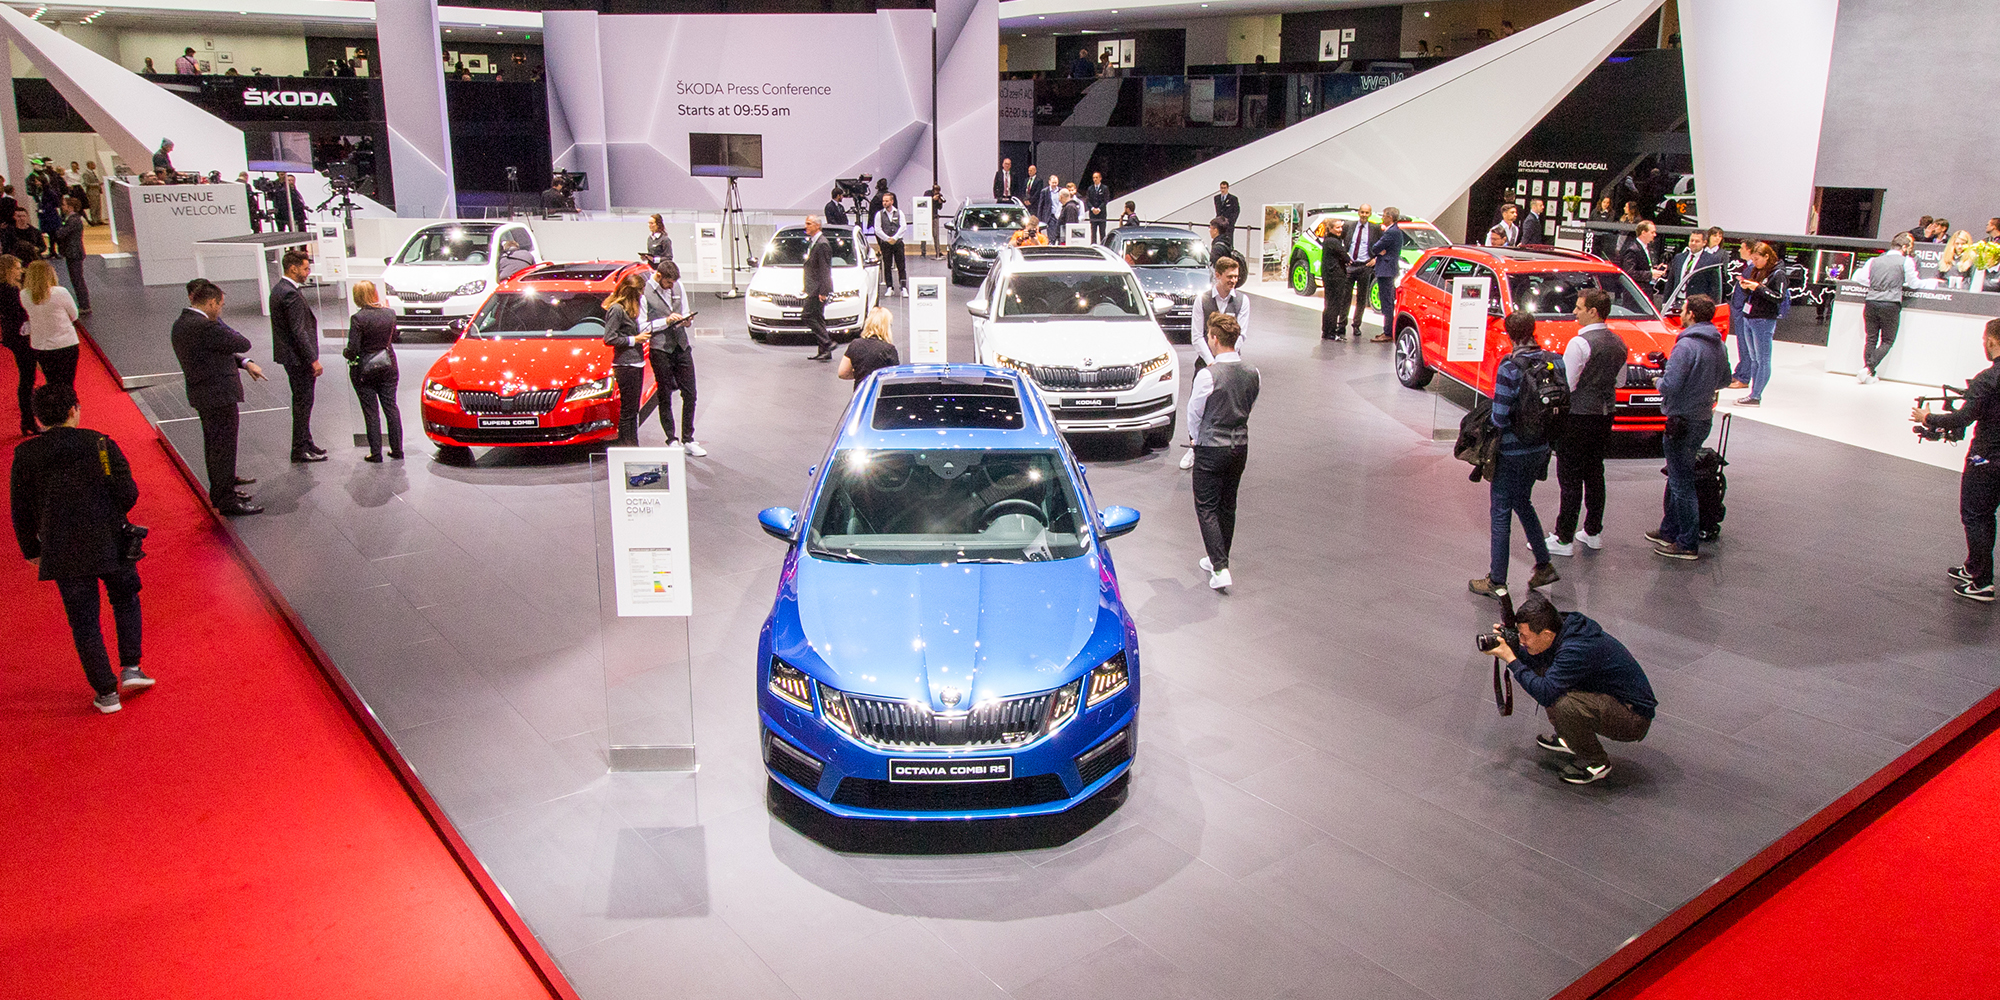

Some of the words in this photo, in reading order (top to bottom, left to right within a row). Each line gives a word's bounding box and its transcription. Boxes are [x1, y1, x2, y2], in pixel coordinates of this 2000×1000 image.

[676, 80, 724, 95] ŠKODA
[727, 83, 759, 95] Press
[762, 82, 831, 95] Conference
[243, 88, 338, 106] ŠKODA
[678, 104, 714, 116] Starts
[718, 106, 730, 116] at
[733, 104, 769, 116] 09:55
[771, 107, 790, 116] am
[1518, 159, 1555, 169] RÉCUPÉREZ
[1555, 162, 1577, 170] VOTRE
[1577, 162, 1608, 171] CADEAU.
[143, 192, 214, 204] BIENVENUE
[171, 205, 236, 216] WELCOME
[626, 498, 660, 506] OCTAVIA
[626, 506, 654, 514] COMBI
[895, 766, 946, 775] OCTAVIA
[950, 766, 987, 774] COMBI
[989, 765, 1006, 773] RS
